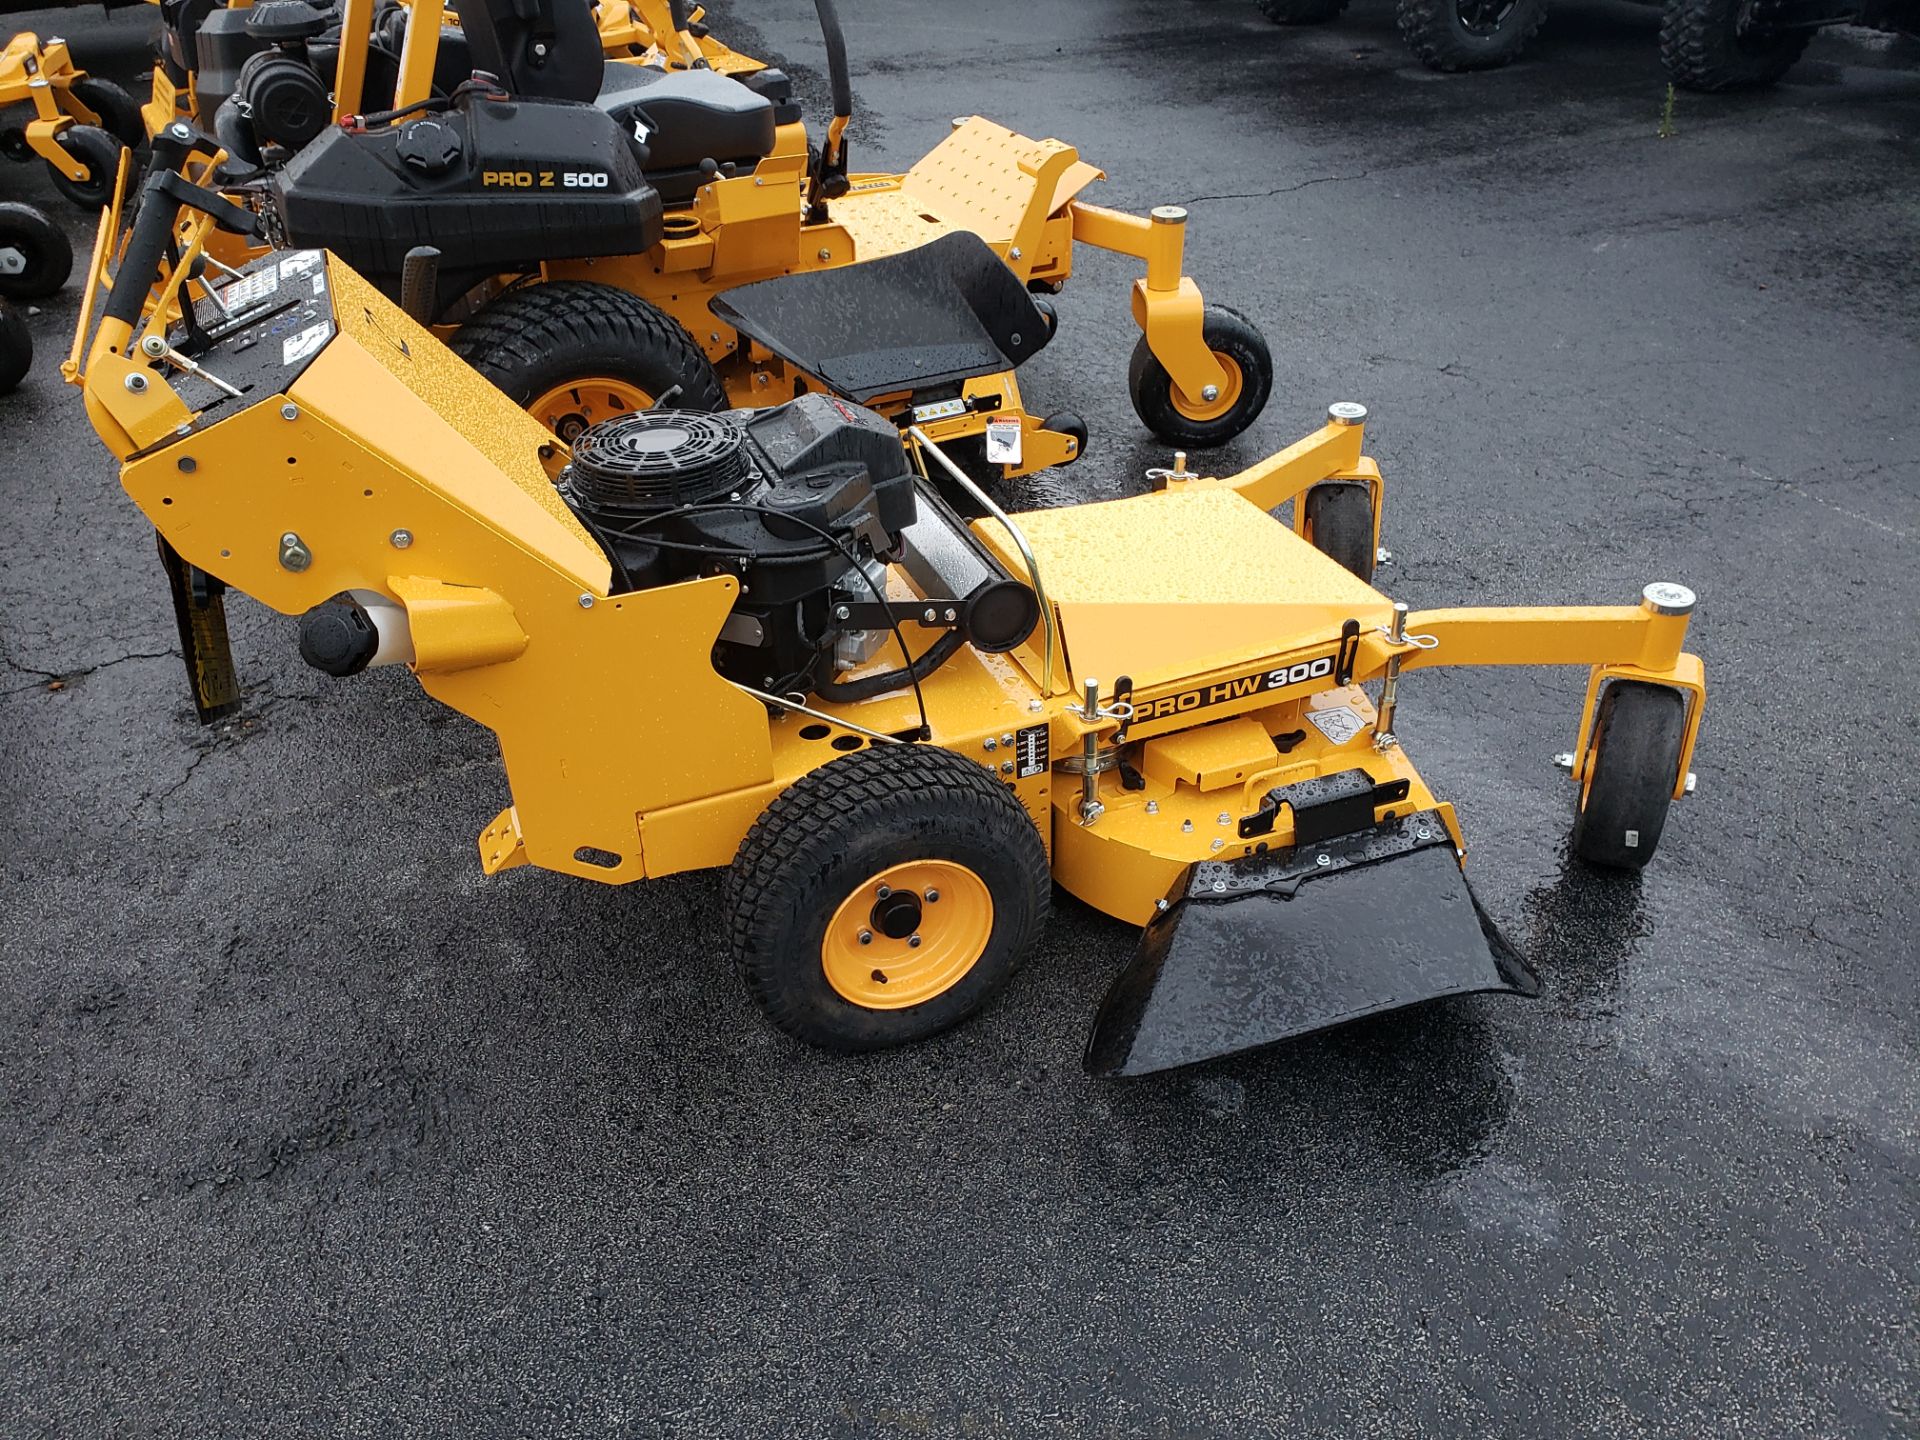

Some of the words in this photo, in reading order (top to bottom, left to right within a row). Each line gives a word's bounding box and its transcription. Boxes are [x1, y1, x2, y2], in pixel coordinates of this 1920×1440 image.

[483, 171, 533, 187] PRO
[539, 171, 555, 187] Z
[563, 172, 608, 188] 500
[1132, 691, 1200, 723] PRO
[1208, 675, 1262, 704] HW
[1267, 658, 1331, 690] 300
